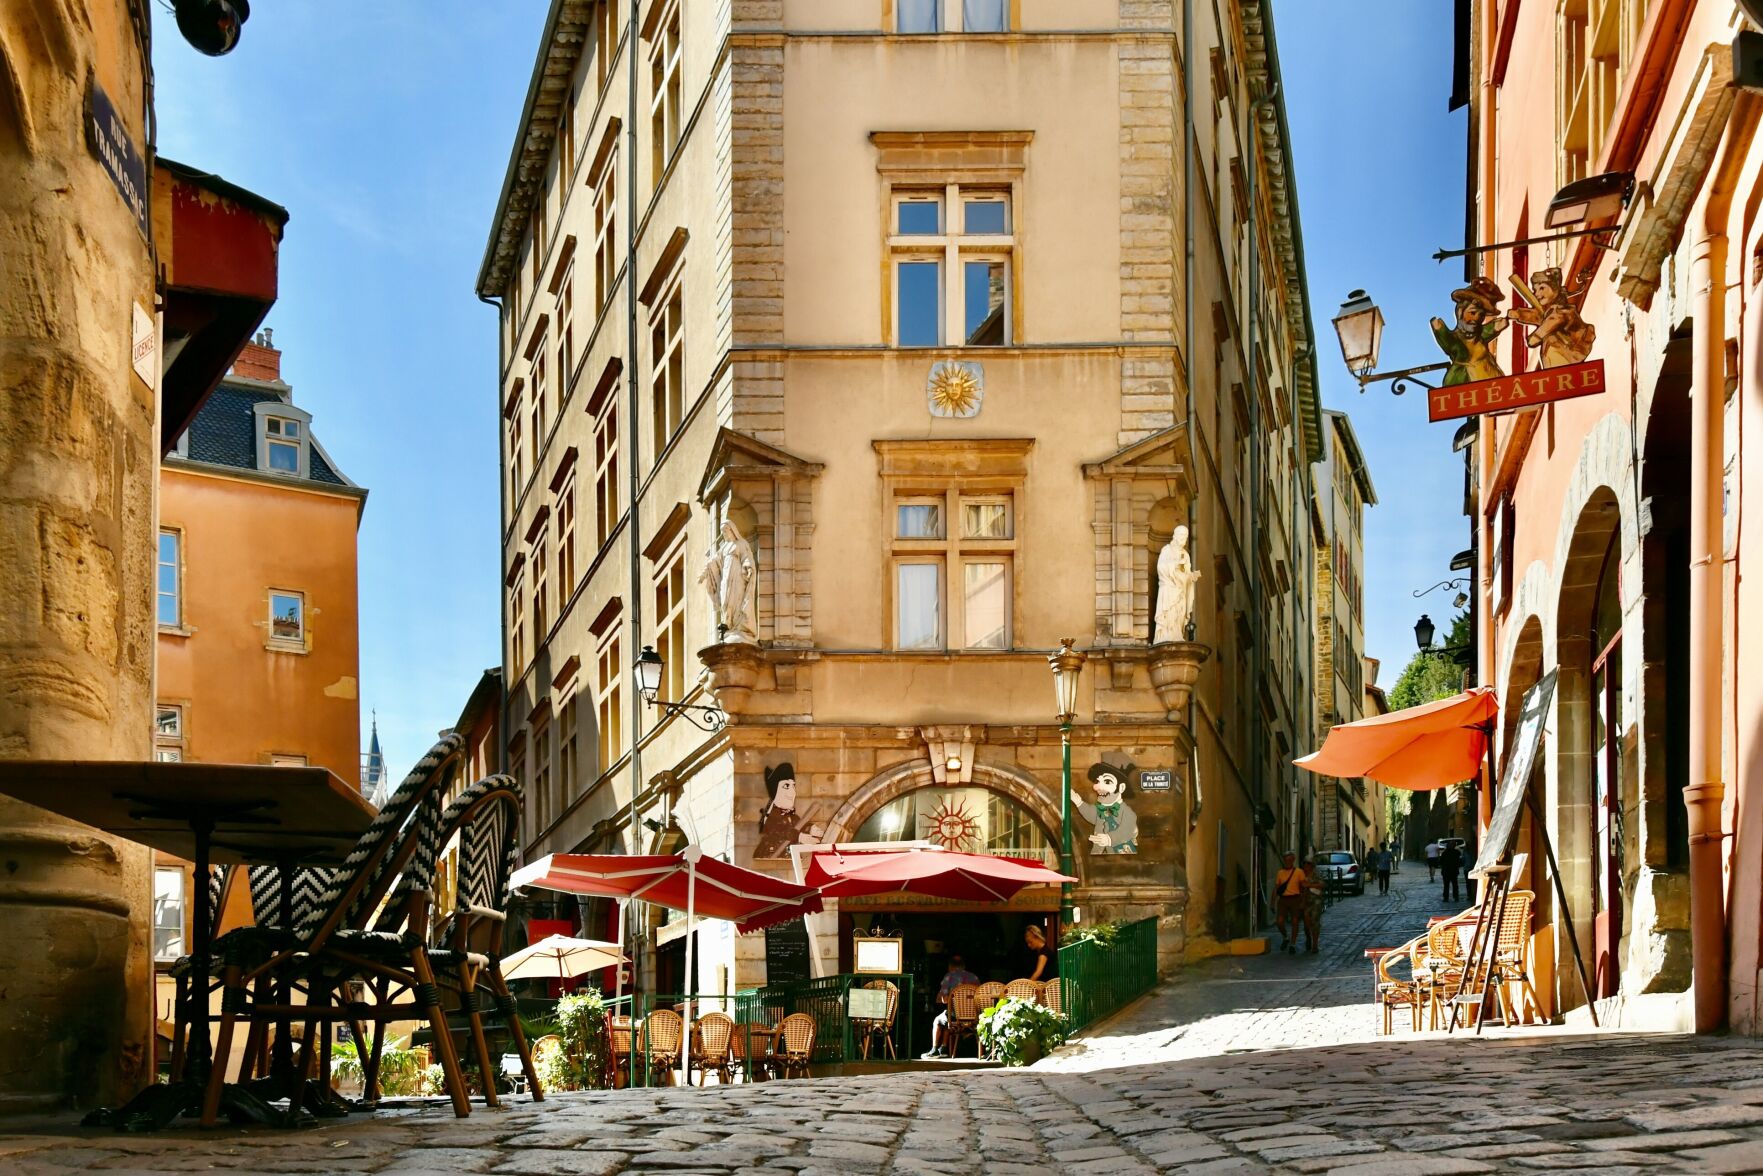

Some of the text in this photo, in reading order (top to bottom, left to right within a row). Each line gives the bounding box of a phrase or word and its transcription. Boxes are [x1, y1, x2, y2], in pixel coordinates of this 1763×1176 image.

[110, 115, 128, 159] RUE
[92, 117, 145, 221] TRAMASSAC
[134, 335, 154, 360] LICENCE
[1433, 368, 1599, 413] THÉÂTRE
